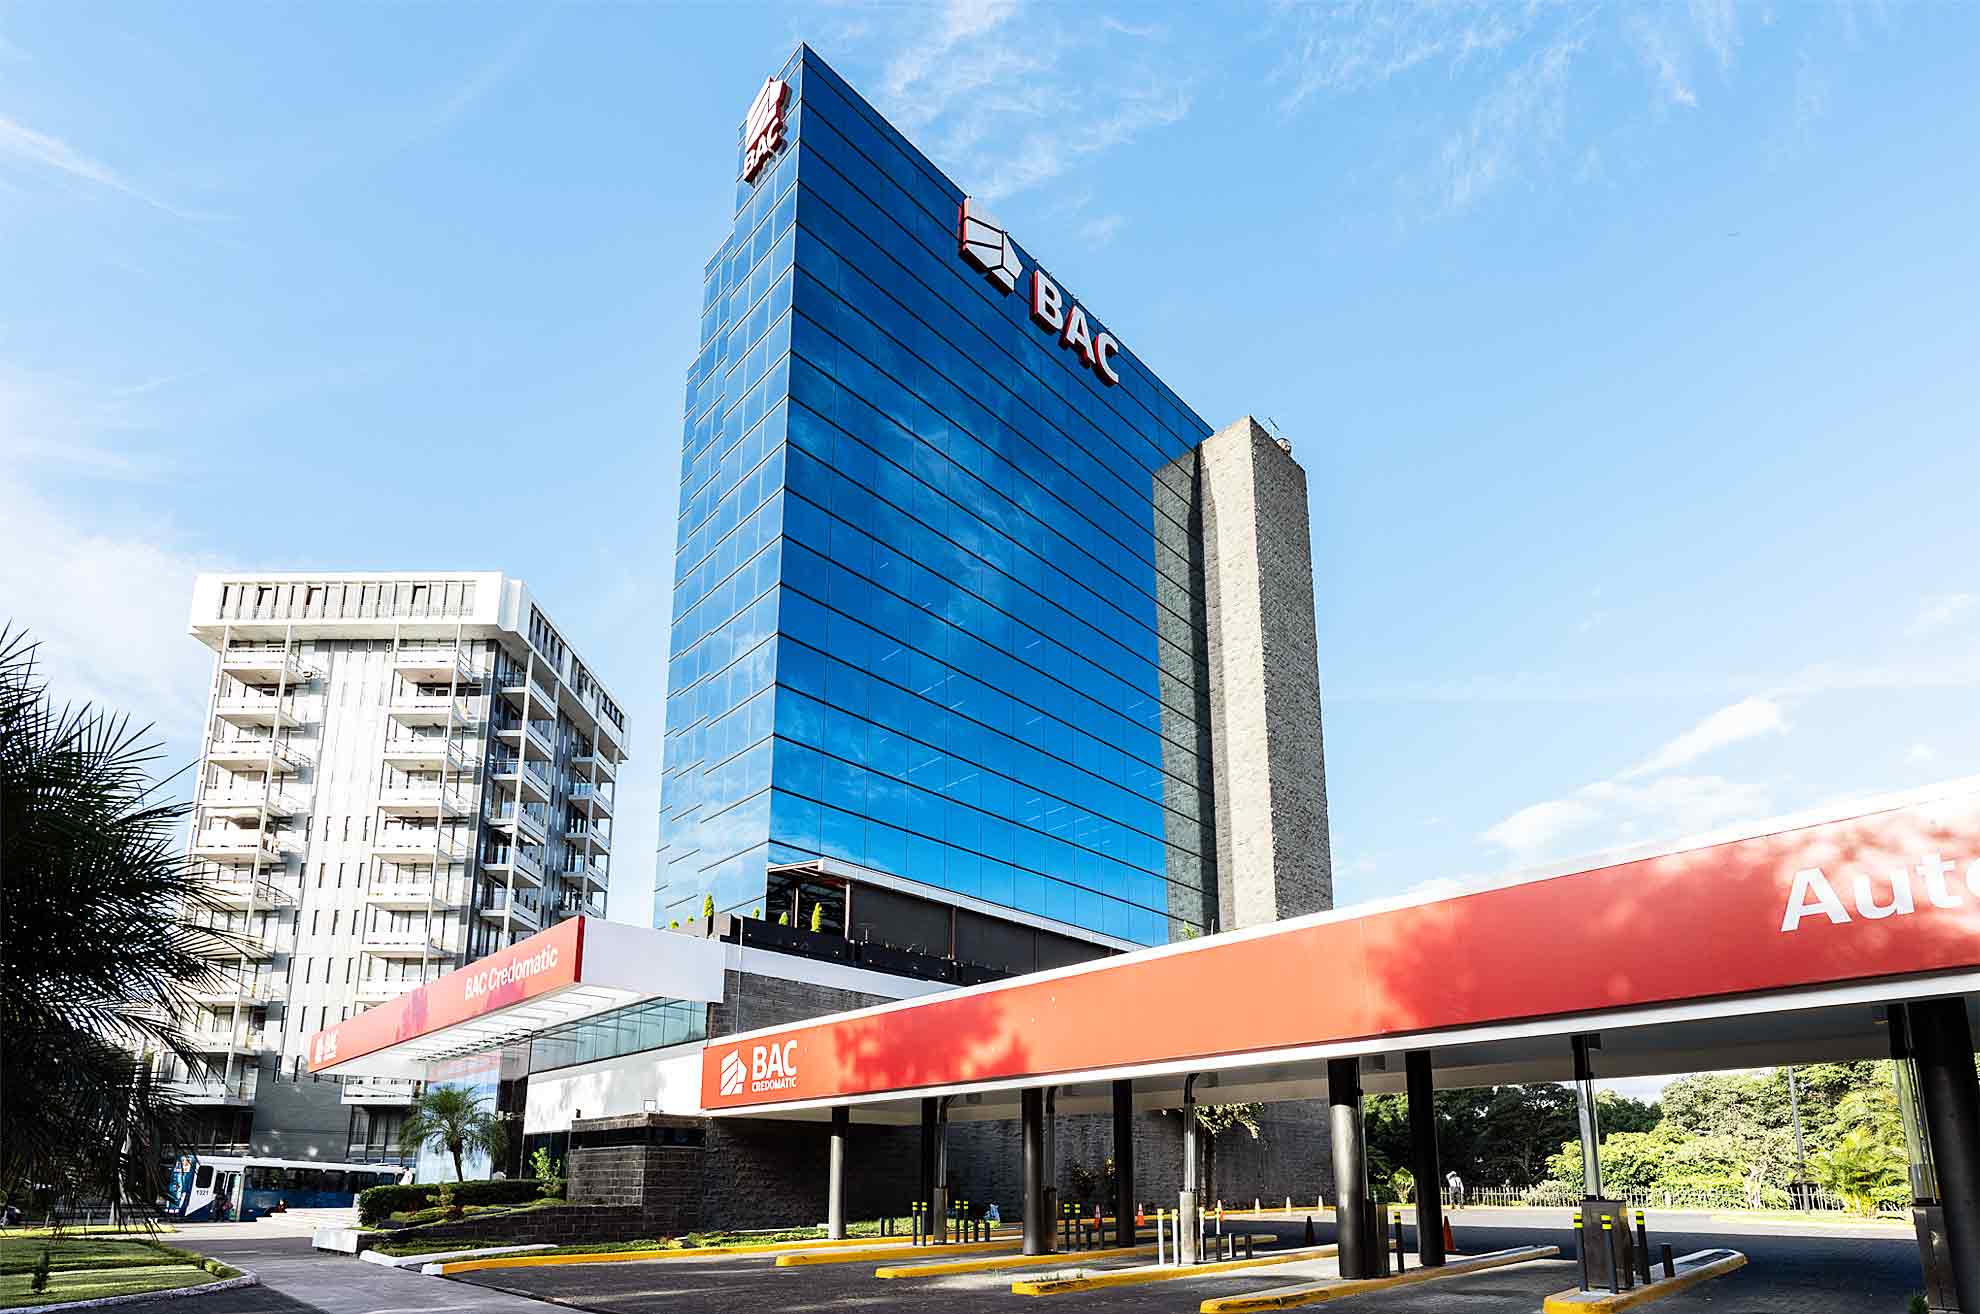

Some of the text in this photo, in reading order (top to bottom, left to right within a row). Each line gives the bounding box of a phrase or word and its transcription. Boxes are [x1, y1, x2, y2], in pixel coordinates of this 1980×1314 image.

[743, 116, 780, 180] BAC
[1034, 269, 1119, 384] BAC
[1781, 853, 1980, 932] Aut
[465, 944, 558, 1001] BAC Credomatic
[752, 1039, 798, 1081] BAC
[752, 1077, 797, 1093] CREDOMATIC
